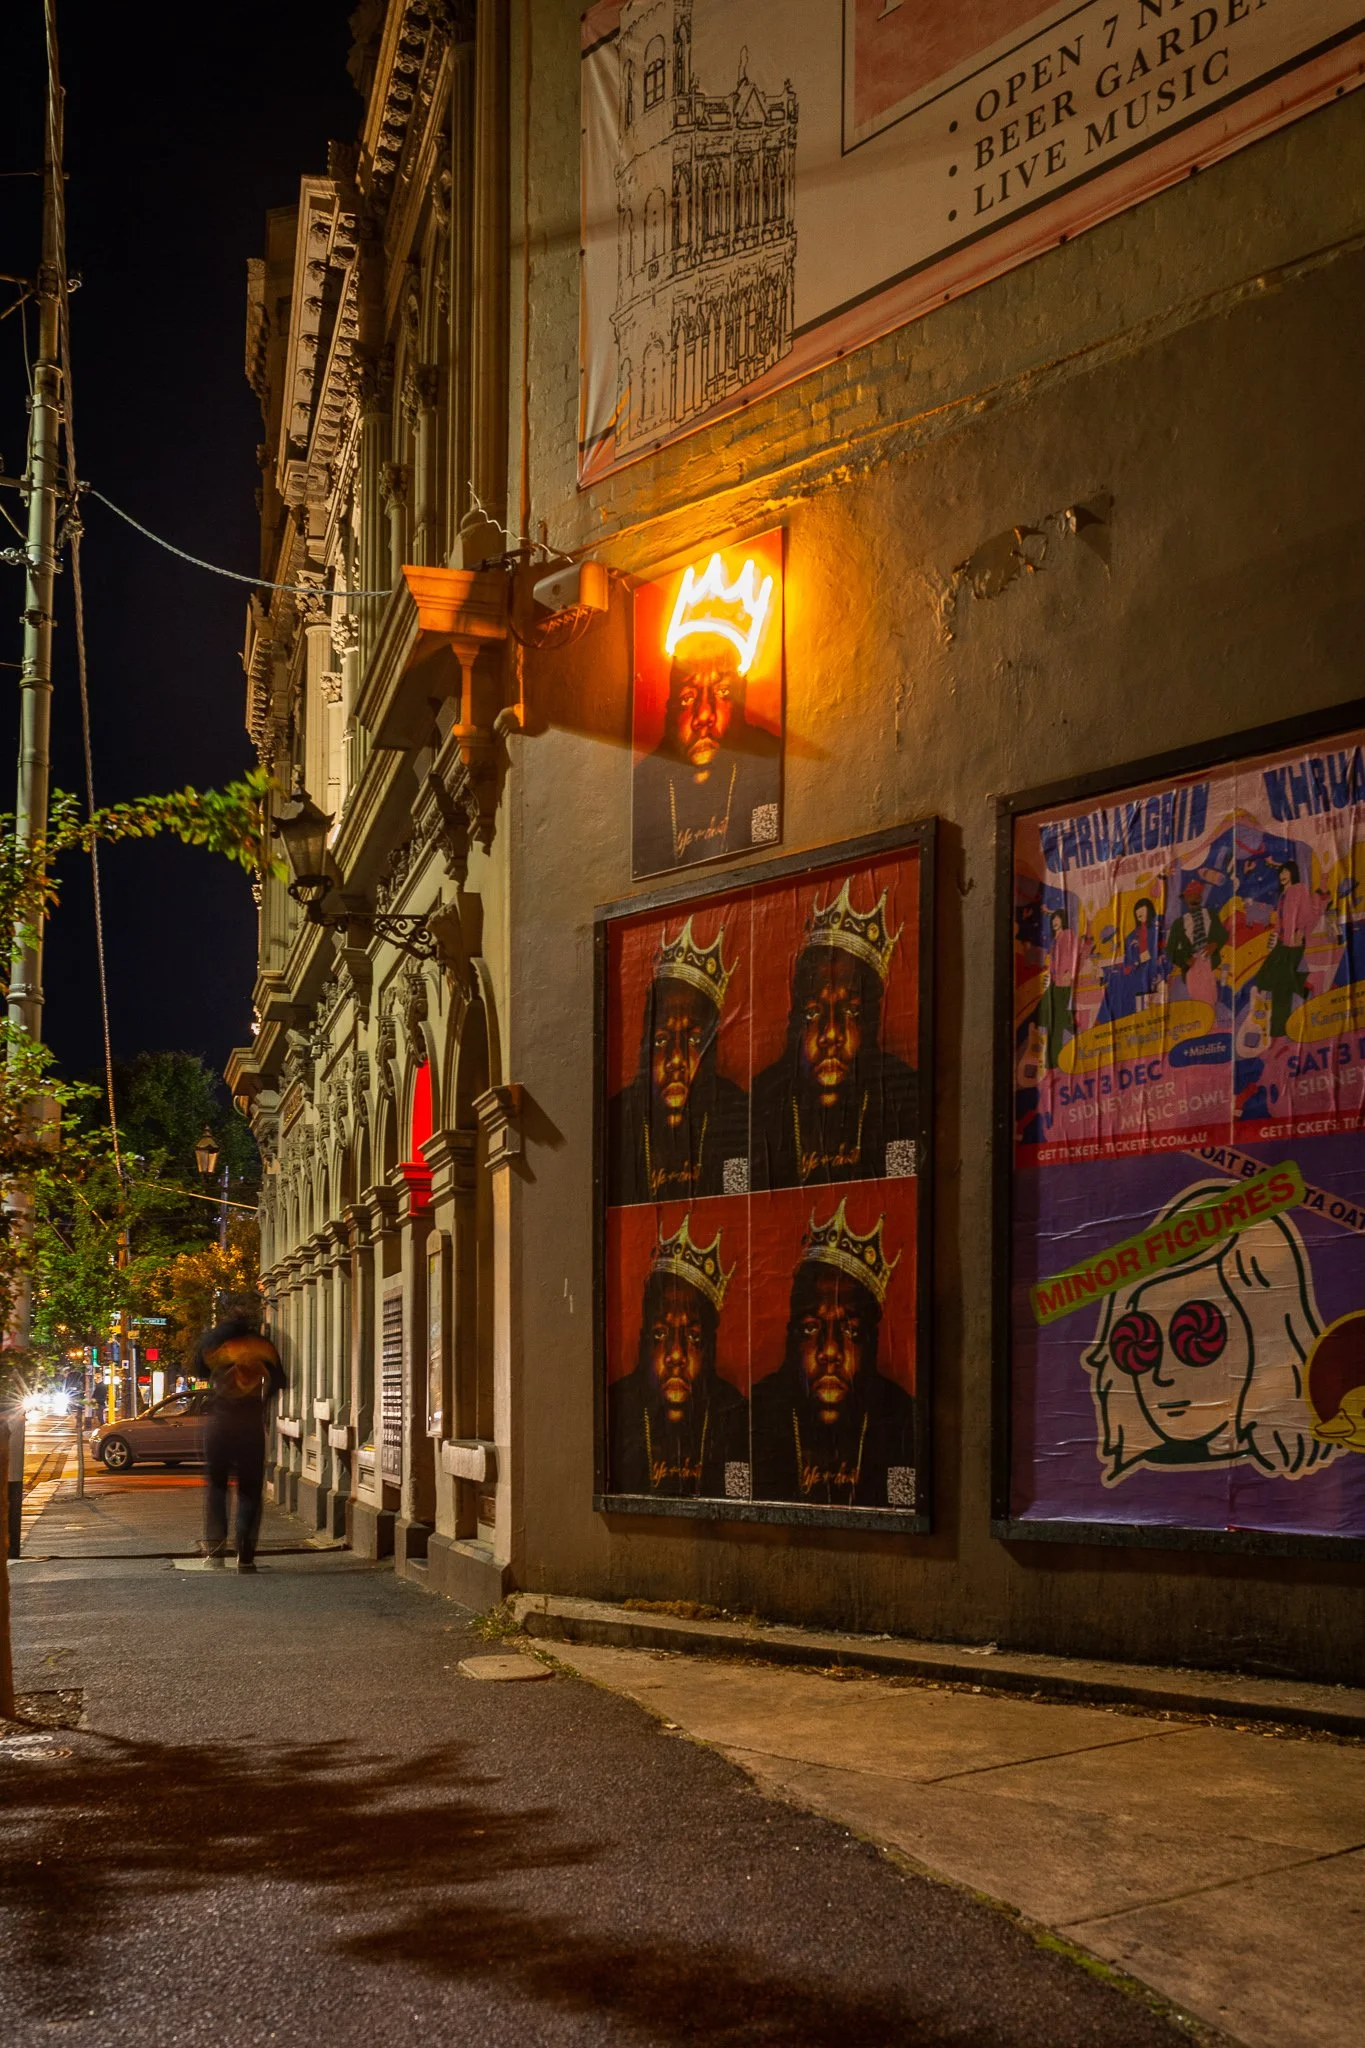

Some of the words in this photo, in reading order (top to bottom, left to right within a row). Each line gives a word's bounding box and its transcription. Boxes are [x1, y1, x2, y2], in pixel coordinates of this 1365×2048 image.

[975, 34, 1084, 123] OPEN
[1102, 14, 1120, 49] 7
[1137, 0, 1189, 29] N
[974, 90, 1077, 171] BEER
[1095, 0, 1267, 98] GARDE
[973, 140, 1066, 216] LIVE
[1083, 47, 1230, 156] MUSIC
[1039, 782, 1210, 874] KHRUANGBIN
[1287, 1047, 1330, 1077] SAT
[1337, 1043, 1351, 1065] 3
[1060, 1077, 1095, 1106] SAT
[1101, 1074, 1112, 1095] 3
[1118, 1060, 1163, 1090] DEC
[1068, 1096, 1128, 1123] SIDNEY
[1132, 1081, 1176, 1106] MYER
[1121, 1102, 1175, 1130] MUSIC
[1178, 1091, 1230, 1115] BOWL
[1260, 1125, 1284, 1138] GET
[1037, 1147, 1058, 1161] GET
[1200, 1147, 1240, 1169] OAT
[1329, 1201, 1365, 1231] OAT
[1036, 1247, 1141, 1316] MINOR
[1146, 1172, 1296, 1273] FIGURES
